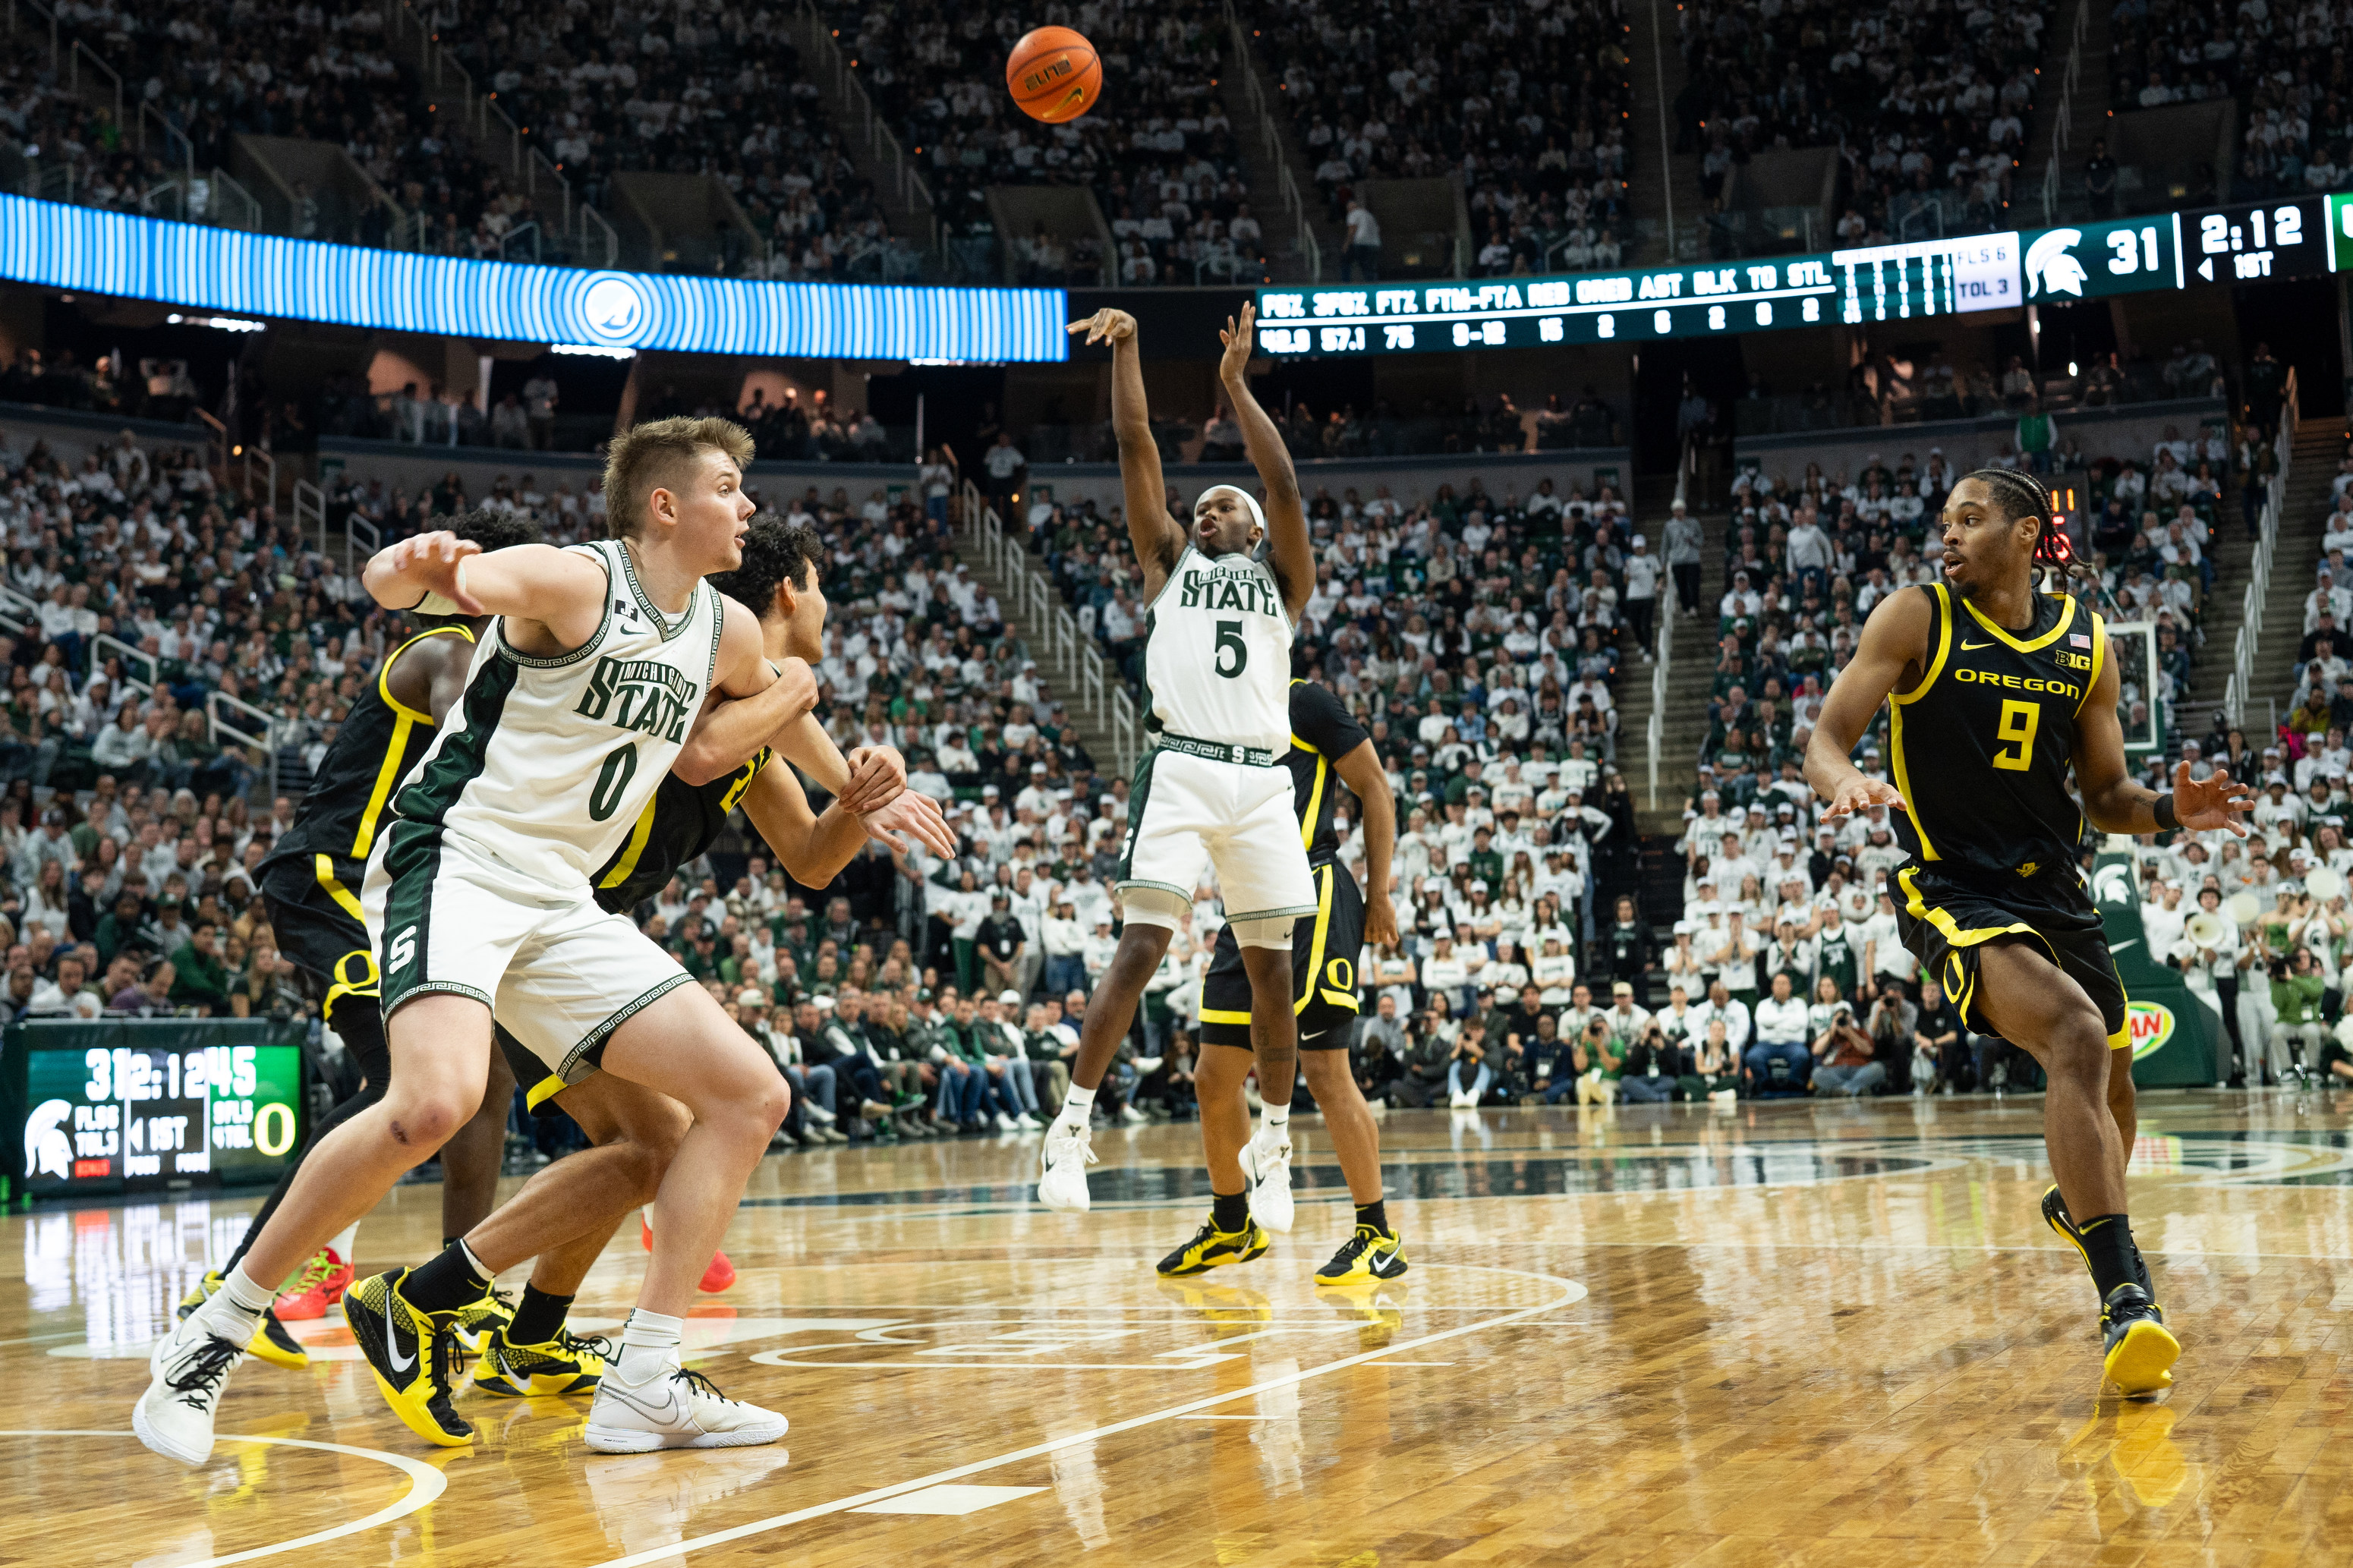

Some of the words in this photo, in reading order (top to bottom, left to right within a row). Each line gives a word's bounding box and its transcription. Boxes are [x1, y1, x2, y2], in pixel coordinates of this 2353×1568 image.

[2106, 226, 2159, 275] 31
[2200, 206, 2302, 253] 2:12
[1958, 249, 1989, 265] FLS
[1997, 247, 2006, 260] 6
[2233, 251, 2274, 279] 1ST
[1375, 290, 1419, 314] FT%
[1425, 285, 1523, 312] FTM-FTA
[1639, 273, 1683, 299] AST
[1693, 269, 1737, 294] BLK
[1747, 265, 1777, 291] TO
[1787, 261, 1832, 286] STL
[1959, 282, 1992, 298] TOL
[1999, 279, 2008, 294] 3
[1383, 324, 1415, 349] 75
[1539, 317, 1564, 342] 15
[1597, 313, 1615, 338] 2
[1708, 305, 1726, 329] 2
[1802, 297, 1820, 322] 2
[1180, 570, 1277, 617] STATE
[1214, 620, 1247, 679] 5
[572, 656, 698, 745] STATE
[623, 662, 684, 696] MICHIGAN
[1955, 669, 2080, 700] OREGON
[1232, 745, 1245, 764] S
[1992, 699, 2040, 771] 9
[589, 741, 637, 821] 0
[389, 925, 417, 974] S
[85, 1048, 125, 1101] 31
[130, 1053, 205, 1100] 2:12
[206, 1046, 257, 1097] 45
[149, 1116, 188, 1151] 1ST
